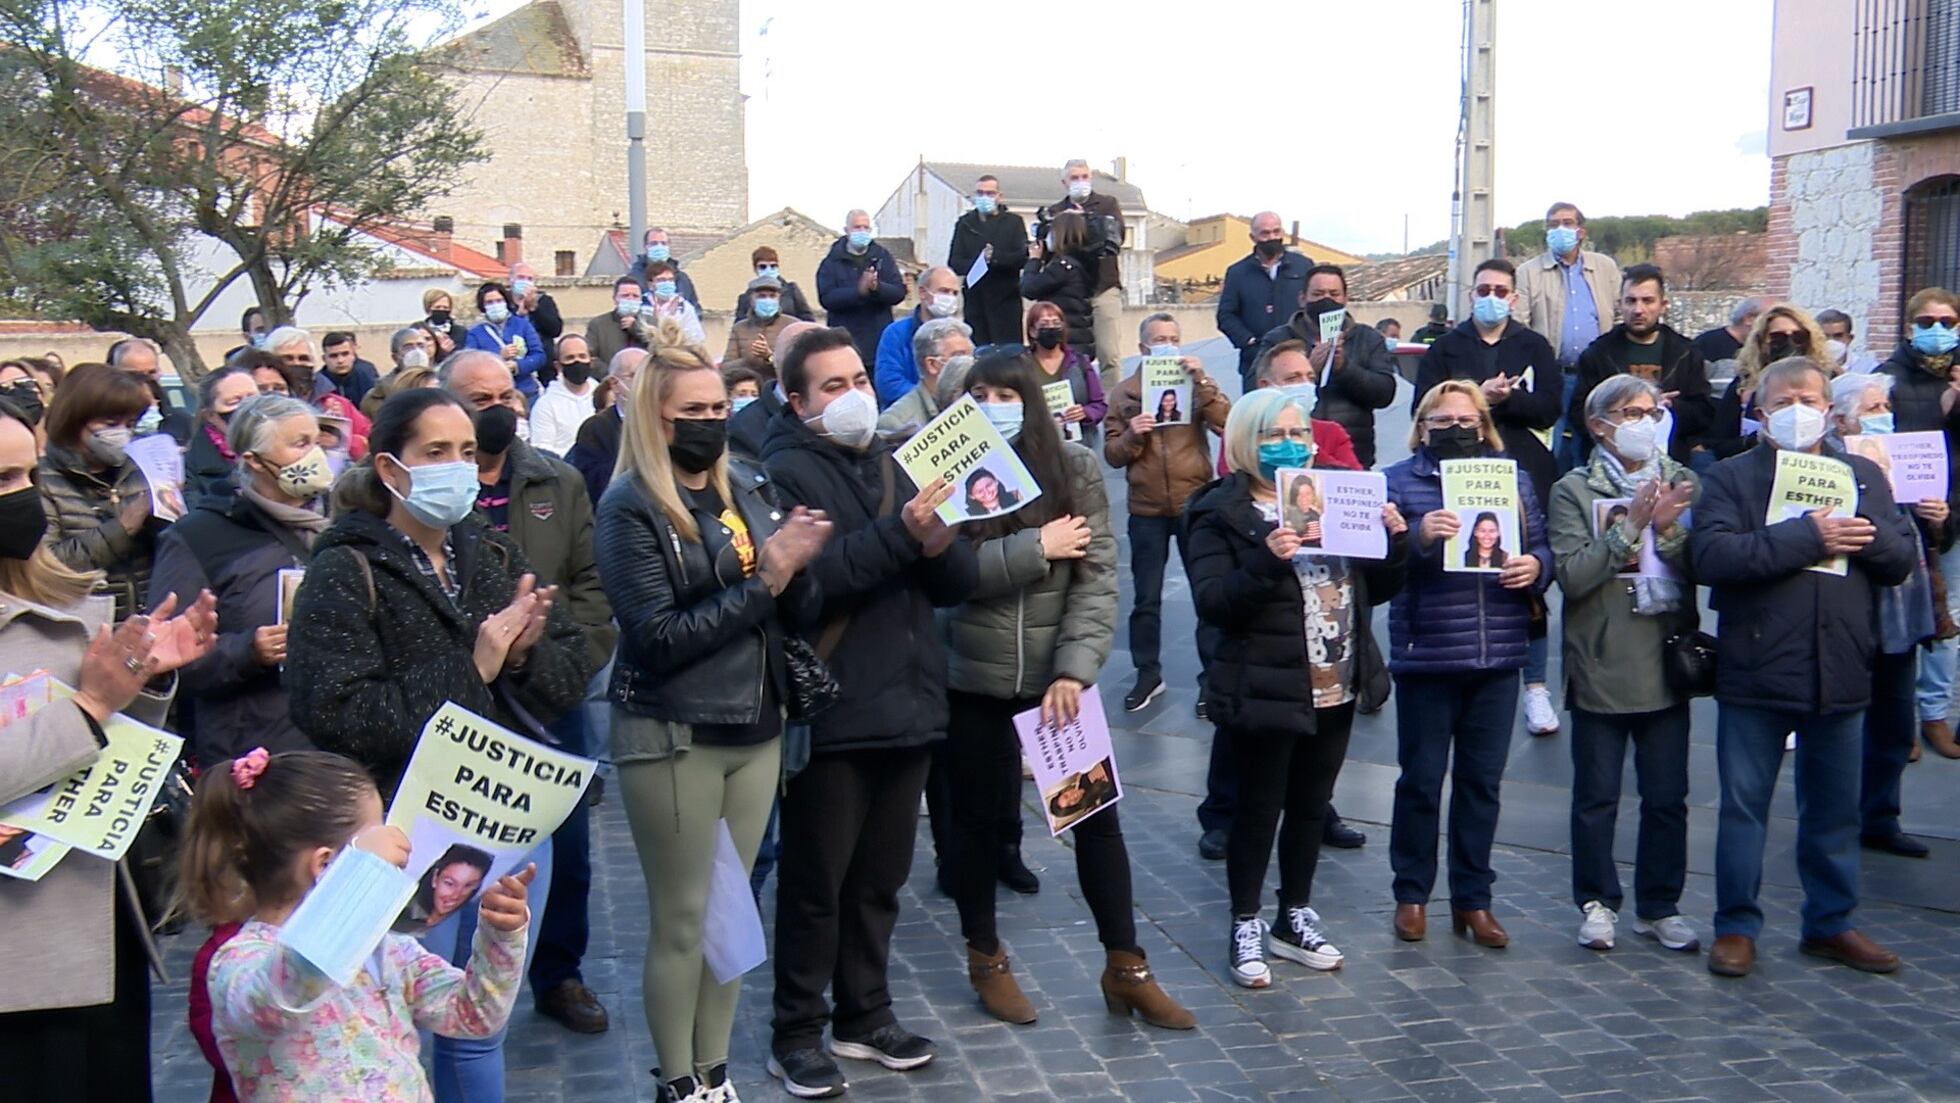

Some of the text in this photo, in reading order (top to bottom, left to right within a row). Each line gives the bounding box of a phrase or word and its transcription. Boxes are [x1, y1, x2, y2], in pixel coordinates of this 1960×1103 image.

[1151, 379, 1185, 387] ESTHER
[903, 402, 976, 465] #JUSTICIA
[930, 432, 971, 467] PARA
[943, 440, 991, 482] STHER
[1446, 464, 1514, 474] #JUSTICIA
[1465, 480, 1501, 490] PARA
[1785, 491, 1843, 507] ESTHER
[1798, 475, 1836, 490] PARA
[1343, 511, 1371, 520] NO TE
[1458, 496, 1509, 506] ESTHER
[1339, 522, 1372, 531] OLVIDA
[435, 715, 583, 789] #JUSTICIA
[46, 766, 93, 824] THER
[84, 759, 129, 818] PARA
[97, 738, 171, 852] #JUSTICIA
[454, 765, 531, 813] PARA
[425, 790, 537, 844] ESTHER
